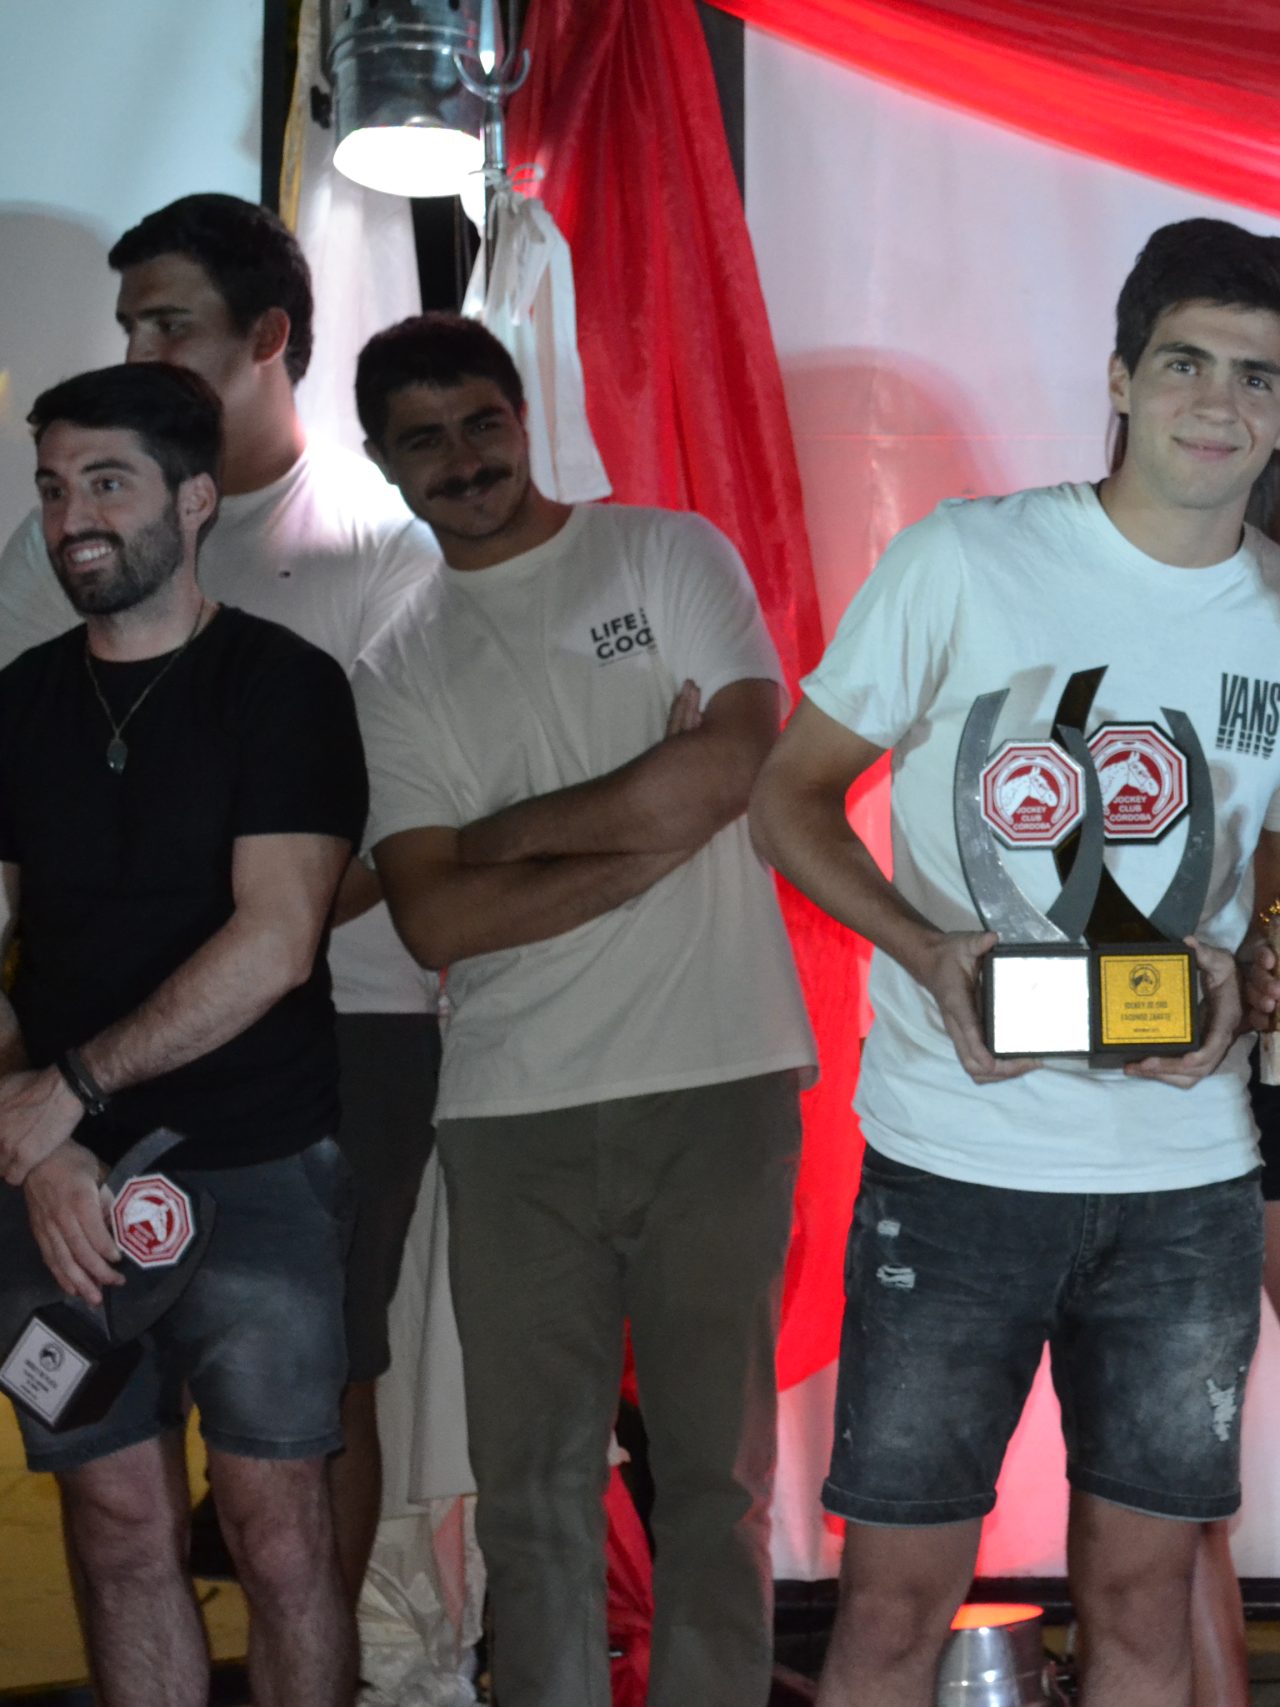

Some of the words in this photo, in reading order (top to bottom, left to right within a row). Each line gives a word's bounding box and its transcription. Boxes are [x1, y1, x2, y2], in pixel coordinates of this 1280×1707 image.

[590, 612, 638, 643] LIFE
[596, 627, 655, 659] GOO
[1118, 805, 1142, 813] CLUB
